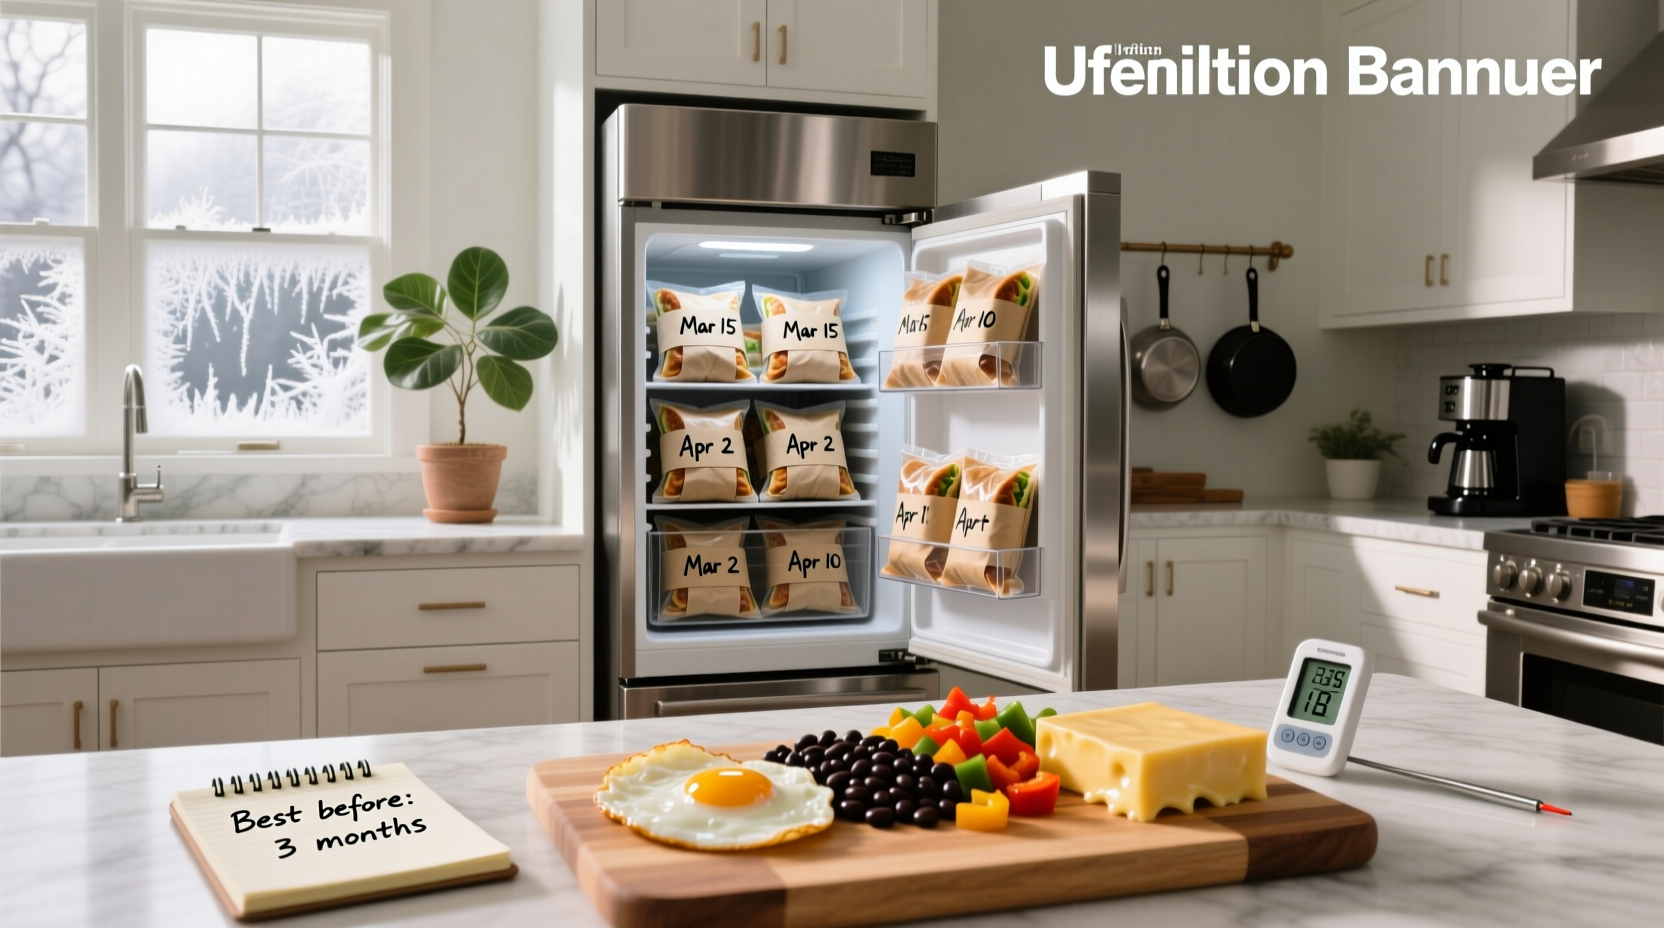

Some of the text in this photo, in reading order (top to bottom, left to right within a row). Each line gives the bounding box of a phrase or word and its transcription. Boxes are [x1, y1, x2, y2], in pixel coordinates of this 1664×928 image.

[680, 315, 737, 335] Mar 15
[783, 320, 838, 341] Mar 15
[978, 310, 996, 328] 10
[679, 434, 734, 461] Apr 2
[786, 433, 835, 459] Apr 2
[896, 501, 918, 531] Apr
[683, 554, 740, 576] Mar 2
[788, 550, 841, 578] Apr 10
[230, 793, 414, 834] Best before:
[274, 817, 427, 859] 3 months
